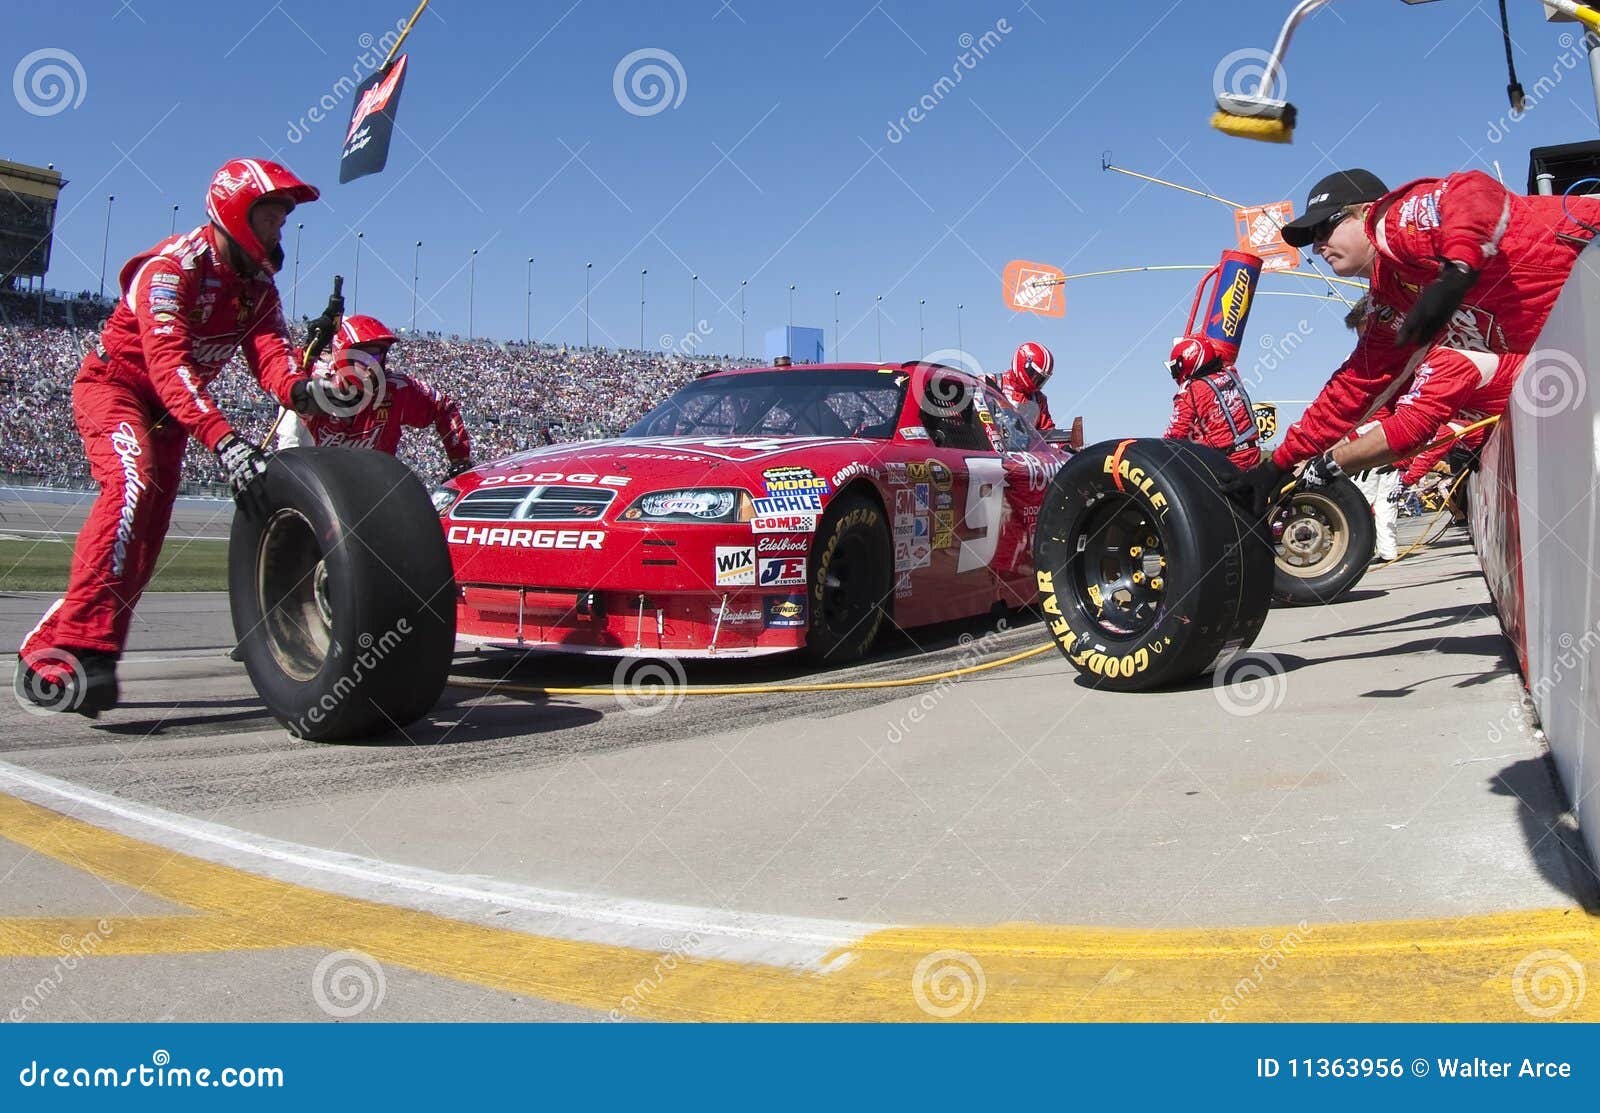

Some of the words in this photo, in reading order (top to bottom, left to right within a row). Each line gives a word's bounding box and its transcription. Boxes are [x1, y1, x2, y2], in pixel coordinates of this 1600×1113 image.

[1223, 269, 1250, 337] SUNOCO
[1256, 415, 1275, 432] PS
[479, 473, 632, 487] DODGE
[766, 478, 826, 491] MOOG
[832, 461, 880, 486] GOODYEAR
[1104, 455, 1170, 512] EAGLE
[111, 421, 146, 577] Budweiser
[755, 495, 821, 514] MAHLE
[754, 517, 801, 529] COMP
[957, 457, 1004, 573] 9
[447, 525, 606, 550] CHARGER
[757, 537, 808, 552] Edelbrock
[717, 549, 753, 572] WIX
[761, 559, 804, 585] JE
[1036, 569, 1149, 678] GOODYEAR
